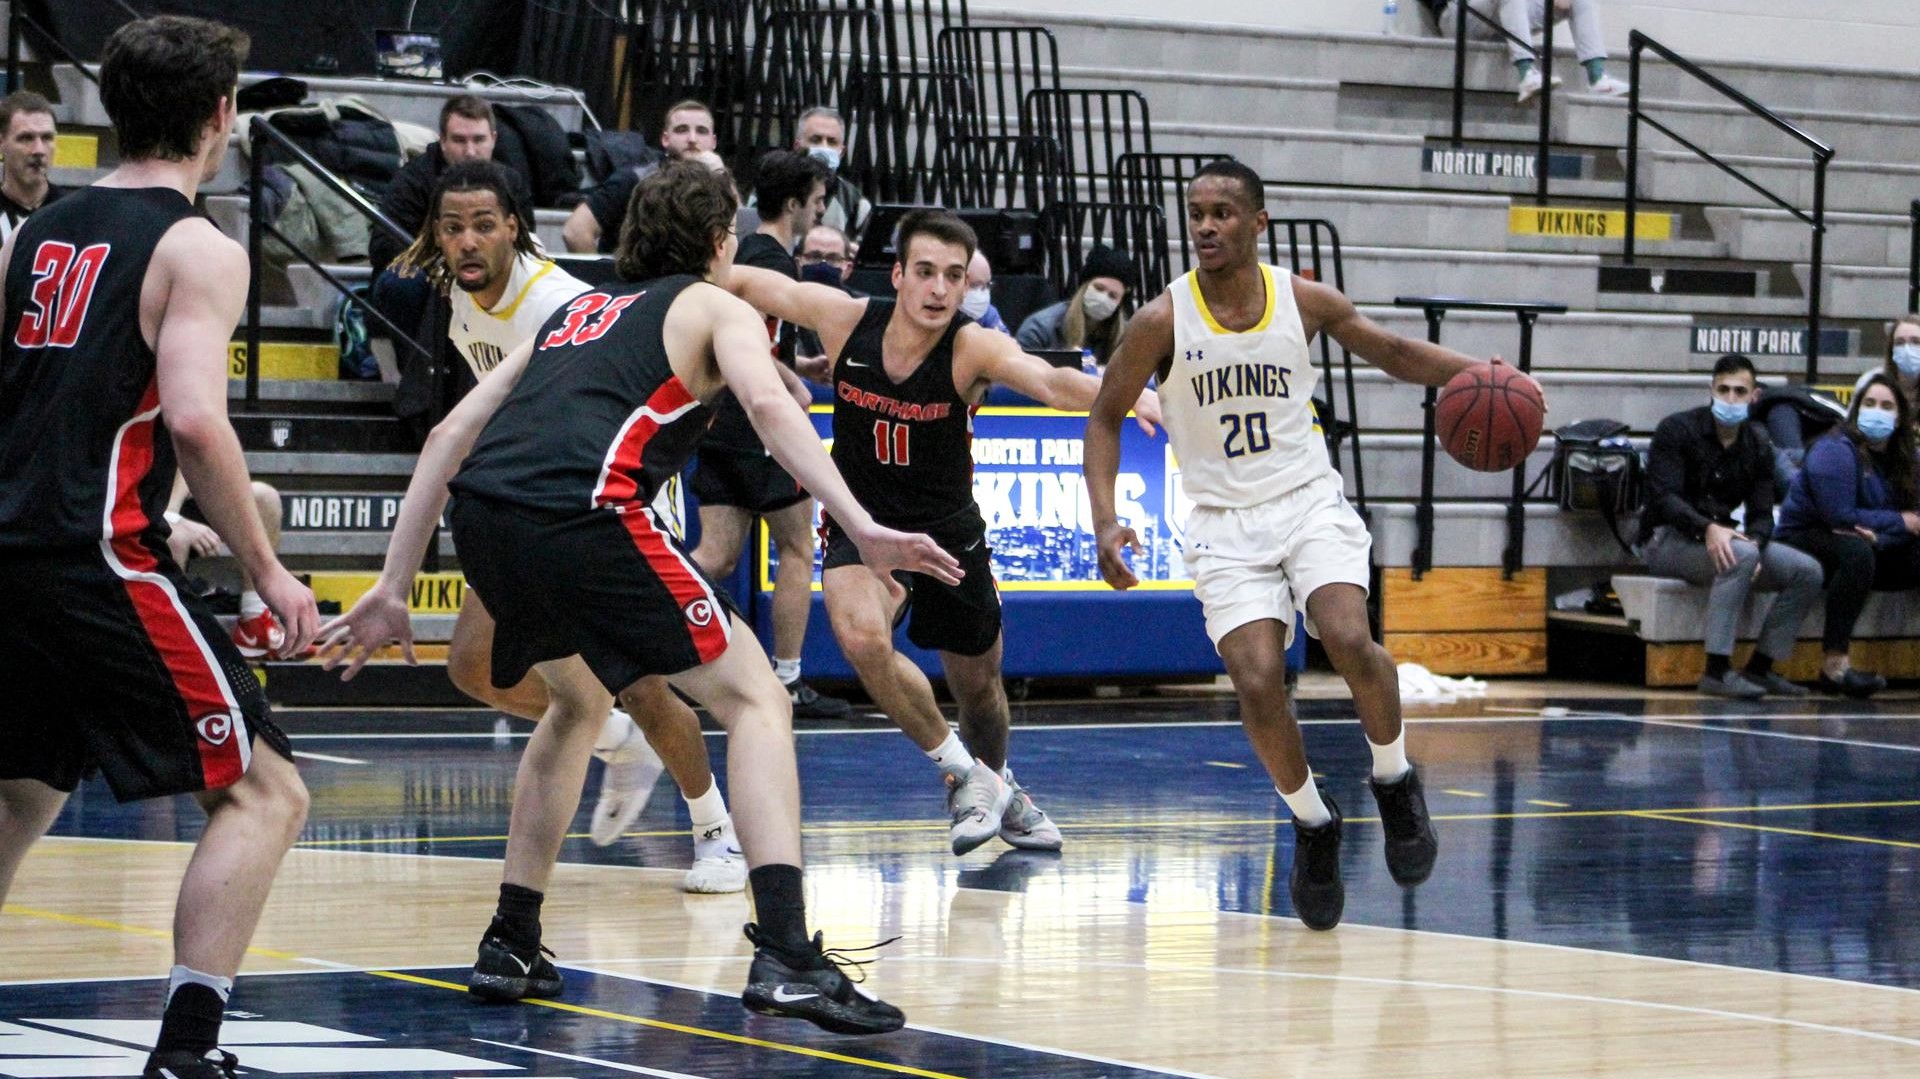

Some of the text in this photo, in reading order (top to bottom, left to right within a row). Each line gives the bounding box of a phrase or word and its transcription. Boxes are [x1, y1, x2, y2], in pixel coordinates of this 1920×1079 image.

[1431, 150, 1536, 177] NORTH PARK
[1536, 211, 1607, 236] VIKINGS
[14, 240, 111, 348] 30
[539, 292, 647, 351] 33
[1696, 328, 1802, 354] NORTH PARK
[838, 381, 951, 421] CARTHAGE
[1191, 364, 1291, 407] VIKINGS
[873, 419, 910, 466] 11
[1041, 439, 1084, 465] PAR
[1219, 411, 1271, 459] 20
[290, 498, 371, 527] NORTH
[411, 579, 462, 608] VIKI
